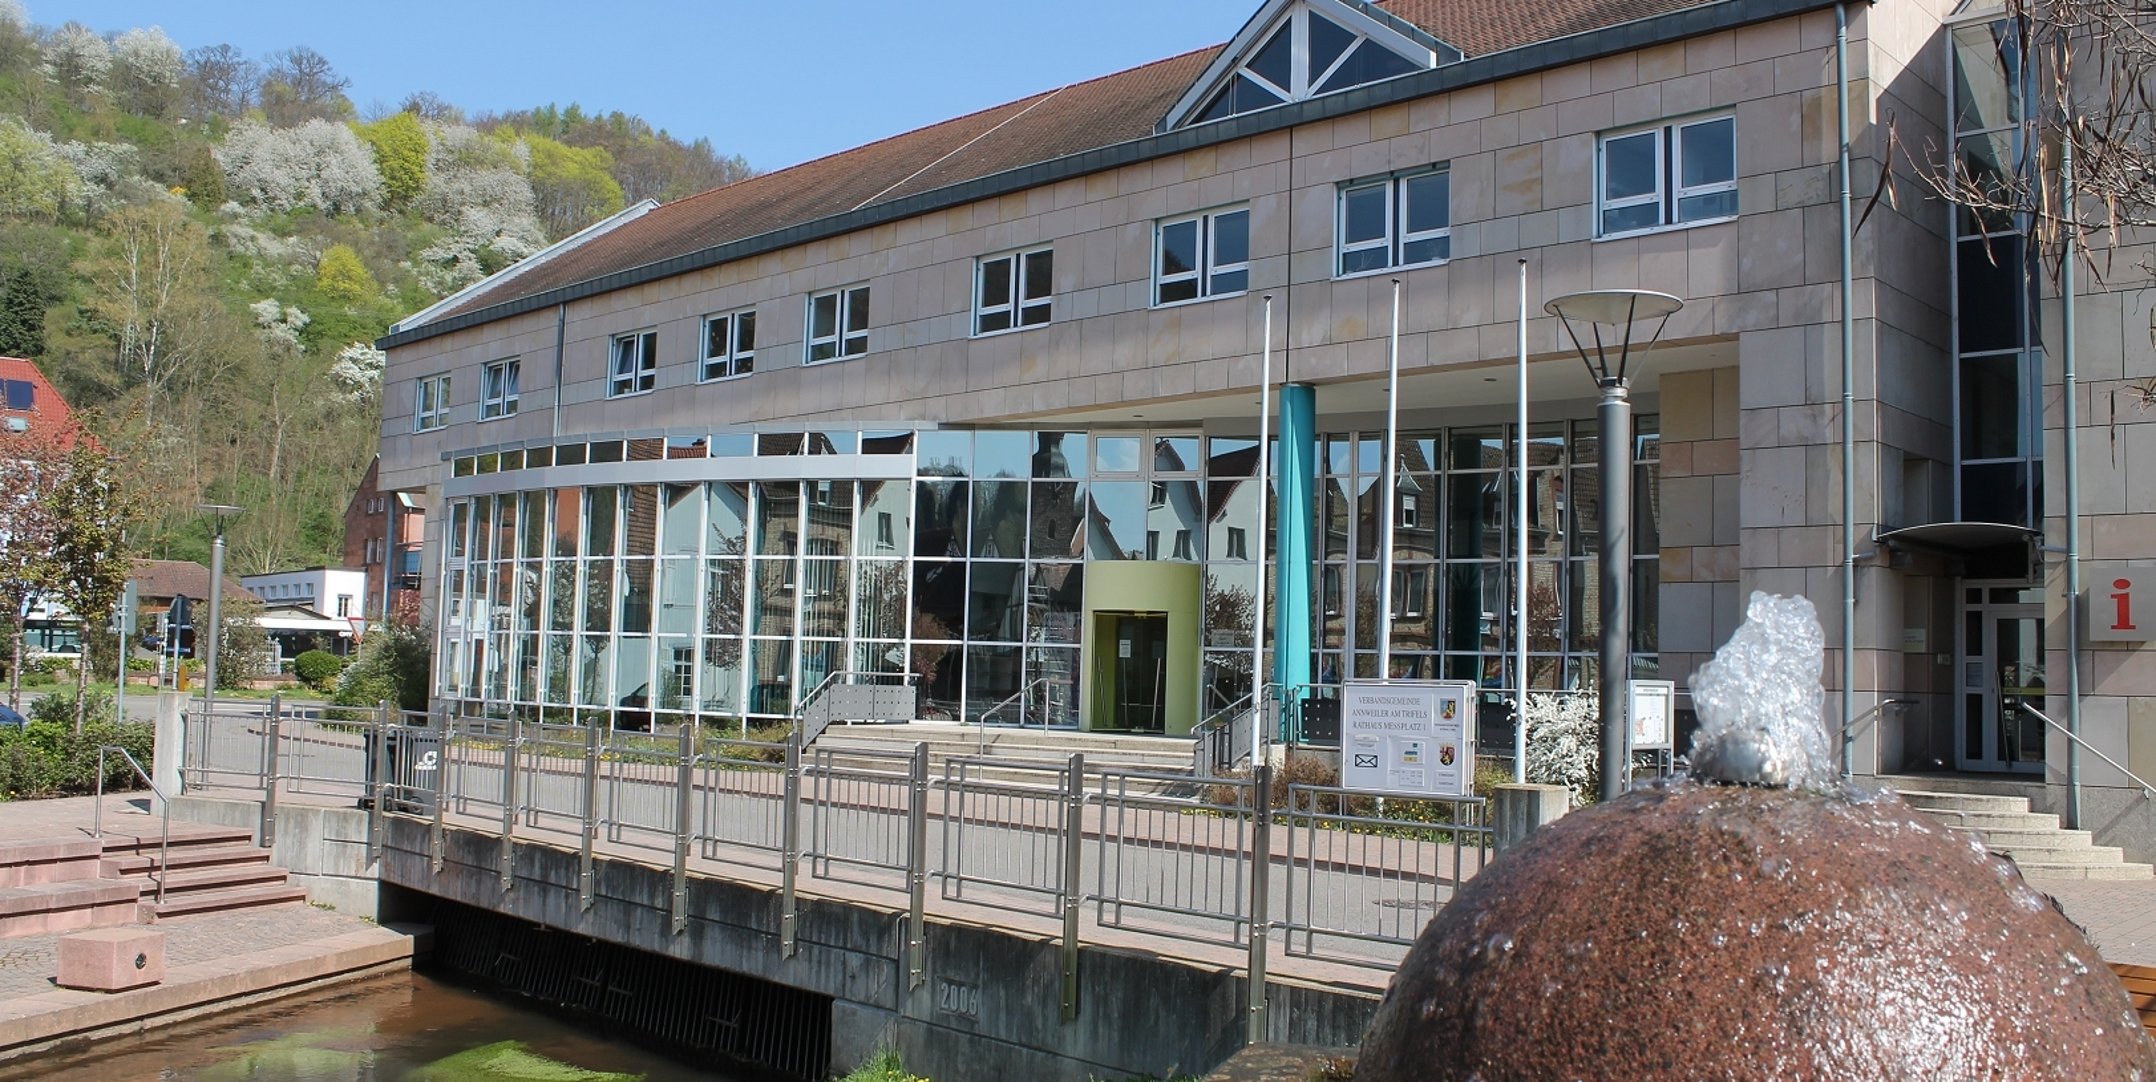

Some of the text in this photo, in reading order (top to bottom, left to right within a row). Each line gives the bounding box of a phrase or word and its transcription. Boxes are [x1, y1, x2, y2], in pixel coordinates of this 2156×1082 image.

[2110, 578, 2137, 630] i
[1358, 697, 1421, 705] VERBANDSGEMEINDE
[1352, 709, 1428, 719] ANNWEILER AM TRIFELS
[1352, 721, 1383, 730] RATHAUS
[940, 982, 978, 1015] 2006
